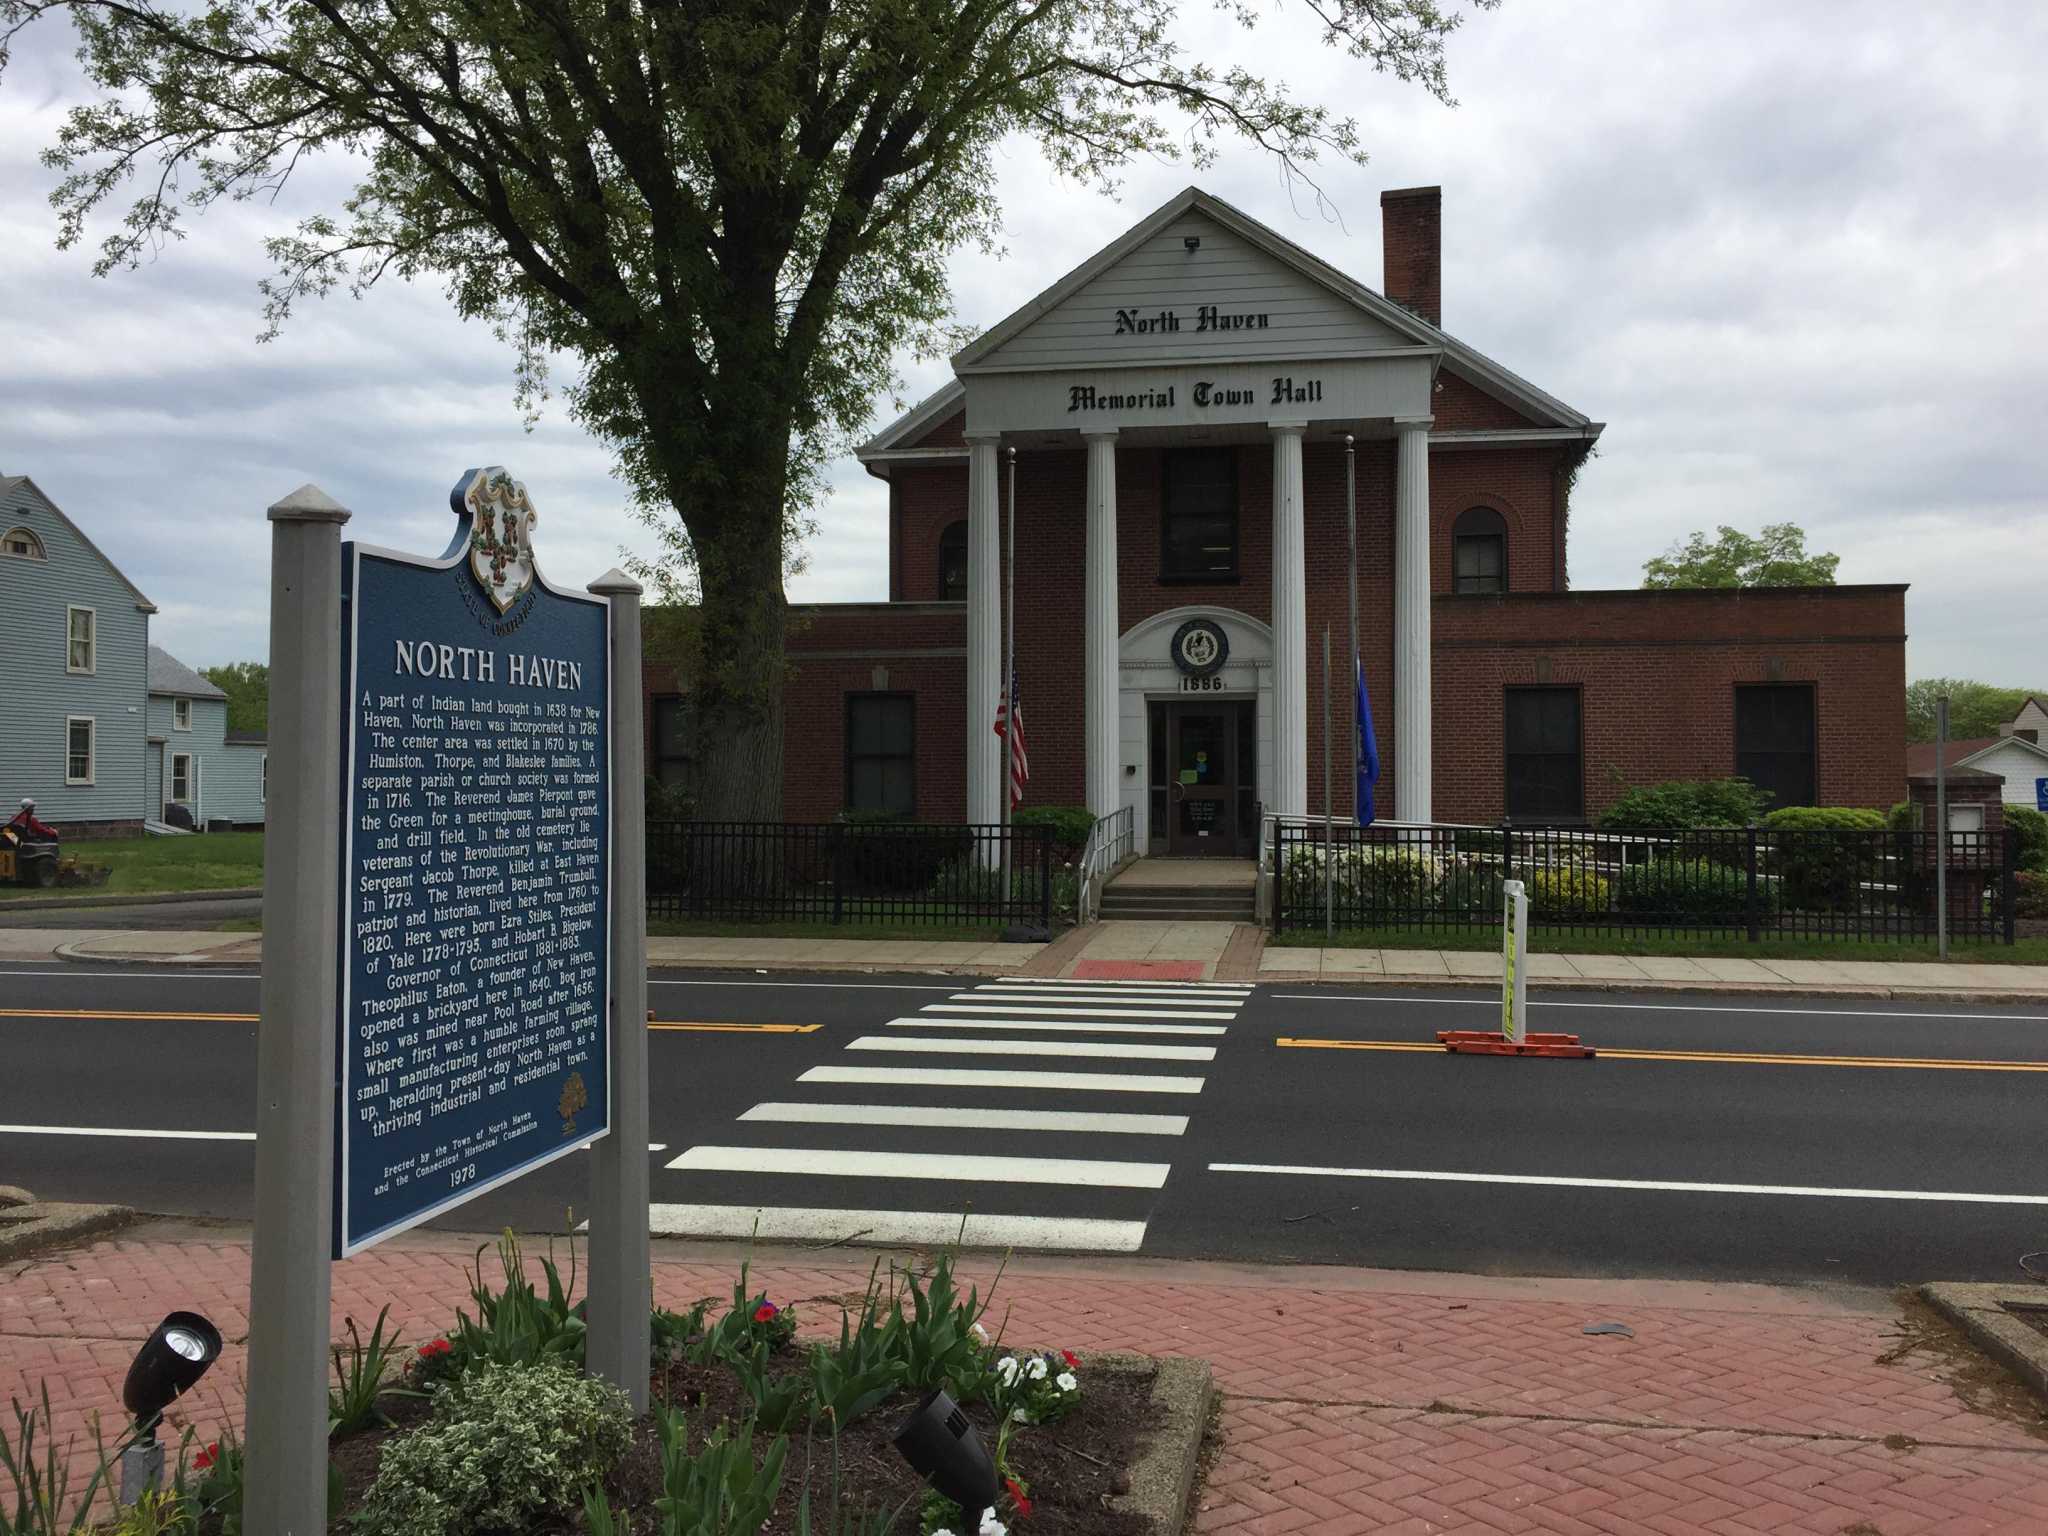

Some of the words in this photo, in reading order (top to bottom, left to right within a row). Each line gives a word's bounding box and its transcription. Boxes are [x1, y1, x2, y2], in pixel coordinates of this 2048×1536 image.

[1115, 309, 1180, 335] North
[1196, 306, 1269, 332] Haven
[1067, 385, 1175, 412] Memorial
[1193, 381, 1254, 408] Town
[1271, 377, 1322, 405] Hall
[395, 640, 495, 682] NORTH
[508, 654, 582, 690] HAVEN
[1183, 676, 1222, 691] 1886
[362, 692, 371, 706] A
[380, 695, 405, 710] part
[412, 696, 423, 709] of
[432, 697, 465, 712] Indian
[472, 699, 492, 713] land
[498, 701, 529, 718] bought
[534, 704, 541, 716] in
[547, 705, 566, 717] 1638
[570, 706, 582, 718] for
[374, 733, 395, 748] The
[402, 735, 439, 748] center
[445, 738, 468, 749] area
[474, 739, 492, 749] was
[497, 737, 528, 750] settled
[532, 738, 540, 750] in
[545, 738, 564, 750] 1670
[569, 739, 578, 753] by
[582, 739, 594, 751] the
[412, 715, 444, 729] North
[451, 717, 482, 731] Haven
[487, 721, 504, 731] was
[510, 720, 564, 736] incorporated
[568, 722, 576, 734] in
[483, 755, 500, 767] and
[506, 755, 546, 767] Blakeslee
[589, 756, 595, 767] A
[362, 774, 412, 792] separate
[421, 773, 454, 791] parish
[462, 776, 472, 786] or
[479, 772, 511, 785] church
[518, 772, 548, 787] society
[554, 774, 568, 784] was
[573, 771, 599, 783] formed
[368, 794, 379, 808] in
[426, 792, 446, 806] The
[454, 790, 500, 805] Reverend
[507, 790, 533, 802] James
[540, 789, 573, 803] Pierpont
[578, 790, 596, 803] gave
[361, 815, 381, 829] the
[389, 813, 423, 828] Green
[432, 811, 448, 825] for
[455, 814, 461, 824] a
[377, 833, 398, 849] and
[407, 831, 431, 846] drill
[478, 827, 487, 840] In
[495, 826, 510, 839] the
[516, 824, 530, 837] old
[536, 822, 575, 837] cemetery
[580, 820, 590, 832] lie
[360, 872, 413, 892] Sergeant
[422, 867, 454, 884] Jacob
[509, 858, 534, 873] killed
[555, 856, 571, 868] East
[576, 853, 599, 865] Haven
[362, 855, 413, 870] veterans
[420, 850, 432, 864] of
[440, 849, 457, 862] the
[465, 842, 530, 861] Revolutionary
[562, 836, 598, 852] including
[357, 914, 399, 937] patriot
[406, 909, 426, 925] and
[490, 896, 512, 912] lived
[518, 894, 538, 908] here
[544, 889, 563, 904] from
[568, 885, 587, 900] 1760
[591, 884, 599, 895] to
[363, 896, 375, 912] in
[428, 888, 448, 902] The
[456, 880, 504, 898] Reverend
[512, 874, 553, 894] Benjamin
[405, 928, 432, 945] Here
[439, 925, 466, 939] were
[472, 920, 495, 933] born
[501, 915, 522, 928] Ezra
[560, 900, 596, 918] President
[367, 957, 379, 973] of
[389, 952, 415, 968] Yale
[492, 933, 509, 948] and
[515, 926, 545, 943] Hobart
[387, 968, 441, 989] Governor
[450, 960, 461, 975] of
[470, 946, 528, 971] Connecticut
[361, 1012, 404, 1039] opened
[412, 1012, 420, 1023] a
[427, 994, 479, 1021] brickyard
[486, 990, 508, 1004] here
[513, 984, 522, 997] in
[560, 970, 575, 985] Bog
[362, 990, 428, 1017] Theophilus
[477, 978, 484, 988] a
[490, 966, 526, 985] founder
[532, 961, 541, 975] of
[547, 958, 564, 971] New
[364, 1040, 389, 1056] also
[397, 1032, 419, 1047] was
[426, 1018, 458, 1039] mined
[465, 1013, 488, 1028] near
[494, 1002, 514, 1020] Pool
[521, 995, 542, 1013] Road
[548, 990, 569, 1005] after
[366, 1056, 404, 1076] Where
[412, 1044, 437, 1063] first
[445, 1038, 464, 1053] was
[471, 1035, 476, 1045] a
[483, 1021, 518, 1042] humble
[525, 1009, 559, 1033] farming
[357, 1077, 389, 1100] small
[399, 1052, 478, 1088] manufacturing
[487, 1031, 539, 1059] enterprises
[546, 1025, 565, 1040] soon
[571, 1015, 598, 1033] sprang
[389, 1083, 442, 1112] heralding
[450, 1060, 510, 1093] present-day
[517, 1048, 543, 1067] North
[548, 1040, 572, 1056] Haven
[577, 1035, 585, 1046] as
[590, 1032, 595, 1041] a
[372, 1109, 422, 1137] thriving
[430, 1085, 481, 1116] industrial
[488, 1077, 506, 1095] and
[514, 1058, 560, 1086] residential
[567, 1051, 588, 1066] town.
[374, 1181, 389, 1196] and
[396, 1174, 409, 1186] the
[416, 1152, 459, 1178] Connecticut
[465, 1136, 497, 1158] Historical
[384, 1157, 415, 1178] Erected
[420, 1153, 430, 1163] by
[435, 1146, 447, 1157] the
[453, 1137, 471, 1150] Town
[476, 1129, 483, 1140] of
[489, 1121, 508, 1135] North
[450, 1163, 476, 1188] 1978
